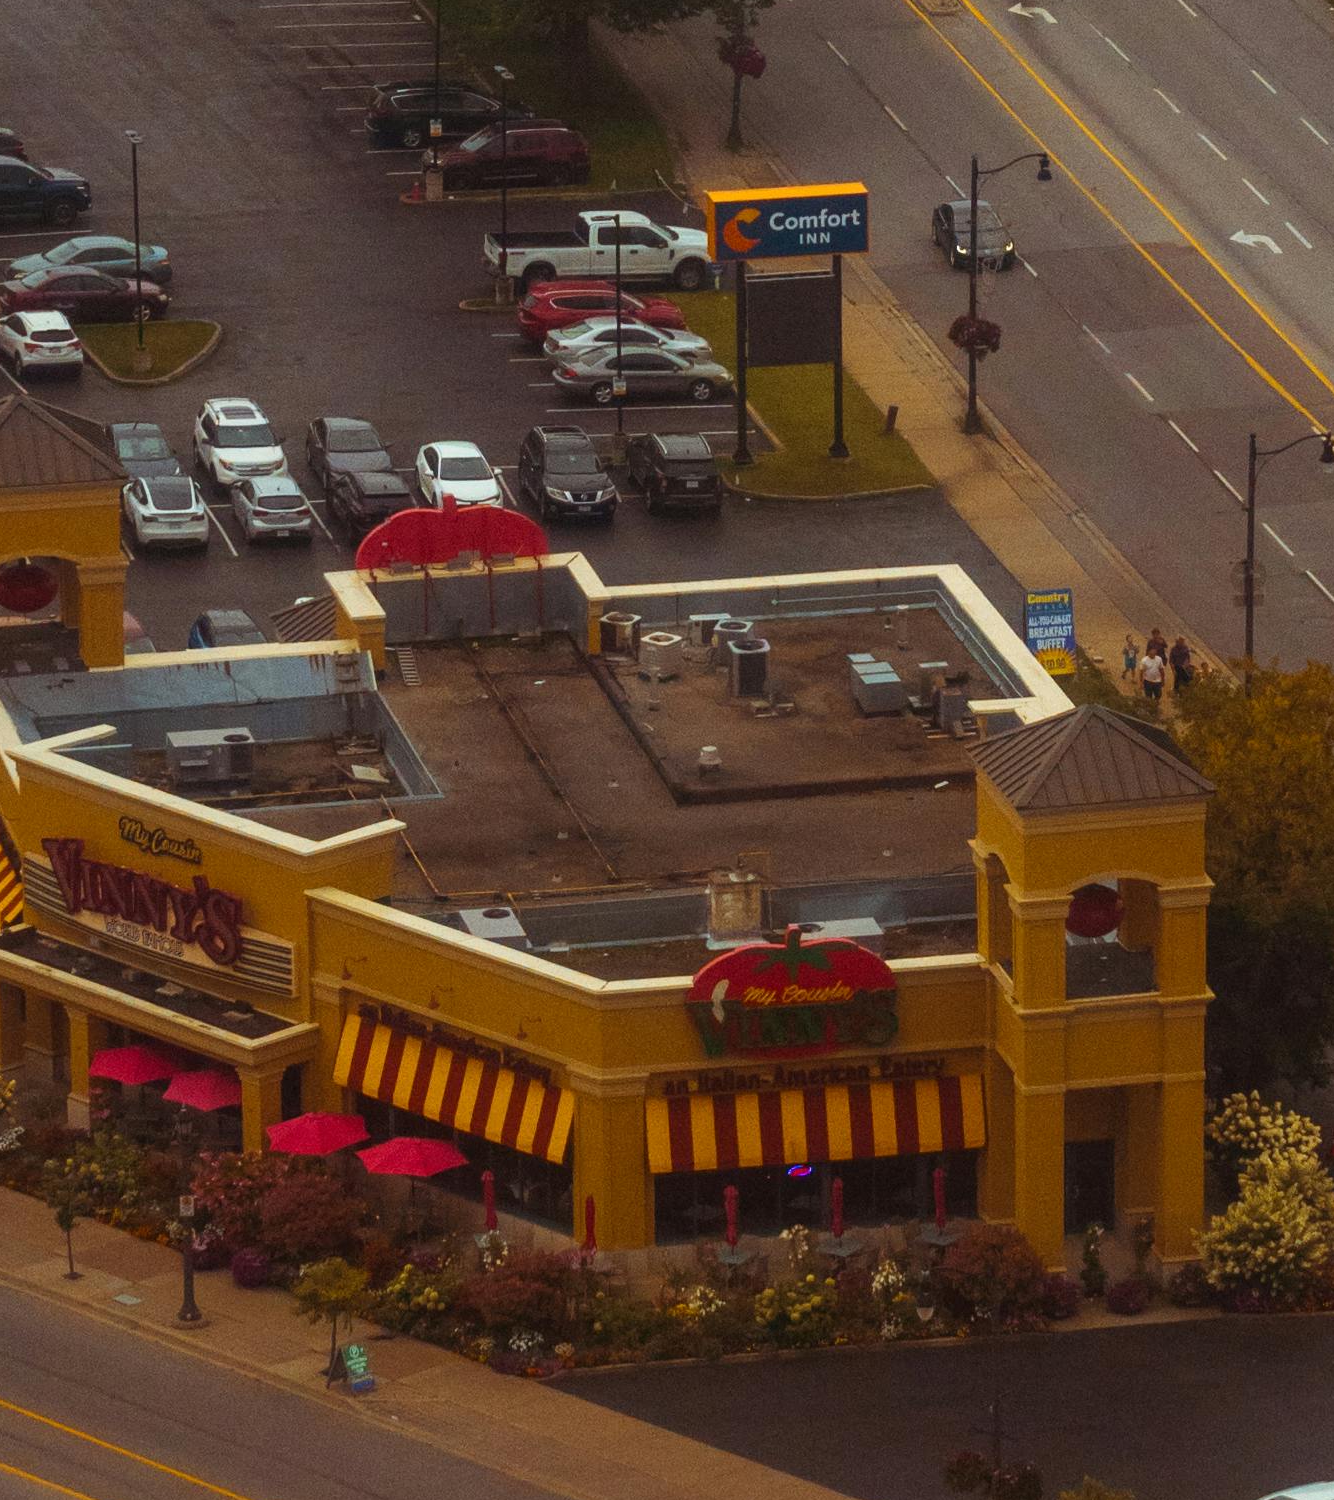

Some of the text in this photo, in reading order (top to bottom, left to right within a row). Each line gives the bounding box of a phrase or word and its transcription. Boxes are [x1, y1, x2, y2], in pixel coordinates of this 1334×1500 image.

[769, 208, 861, 231] Comfort
[799, 232, 830, 245] INN
[1028, 625, 1072, 639] BREAKFAST
[1036, 637, 1066, 649] BUFFET
[119, 815, 203, 865] My Cousin
[41, 837, 244, 966] VINNY'S
[106, 918, 185, 958] WORLD FAMOUS
[743, 979, 854, 1005] My Cousin
[879, 1055, 946, 1081] Eatery
